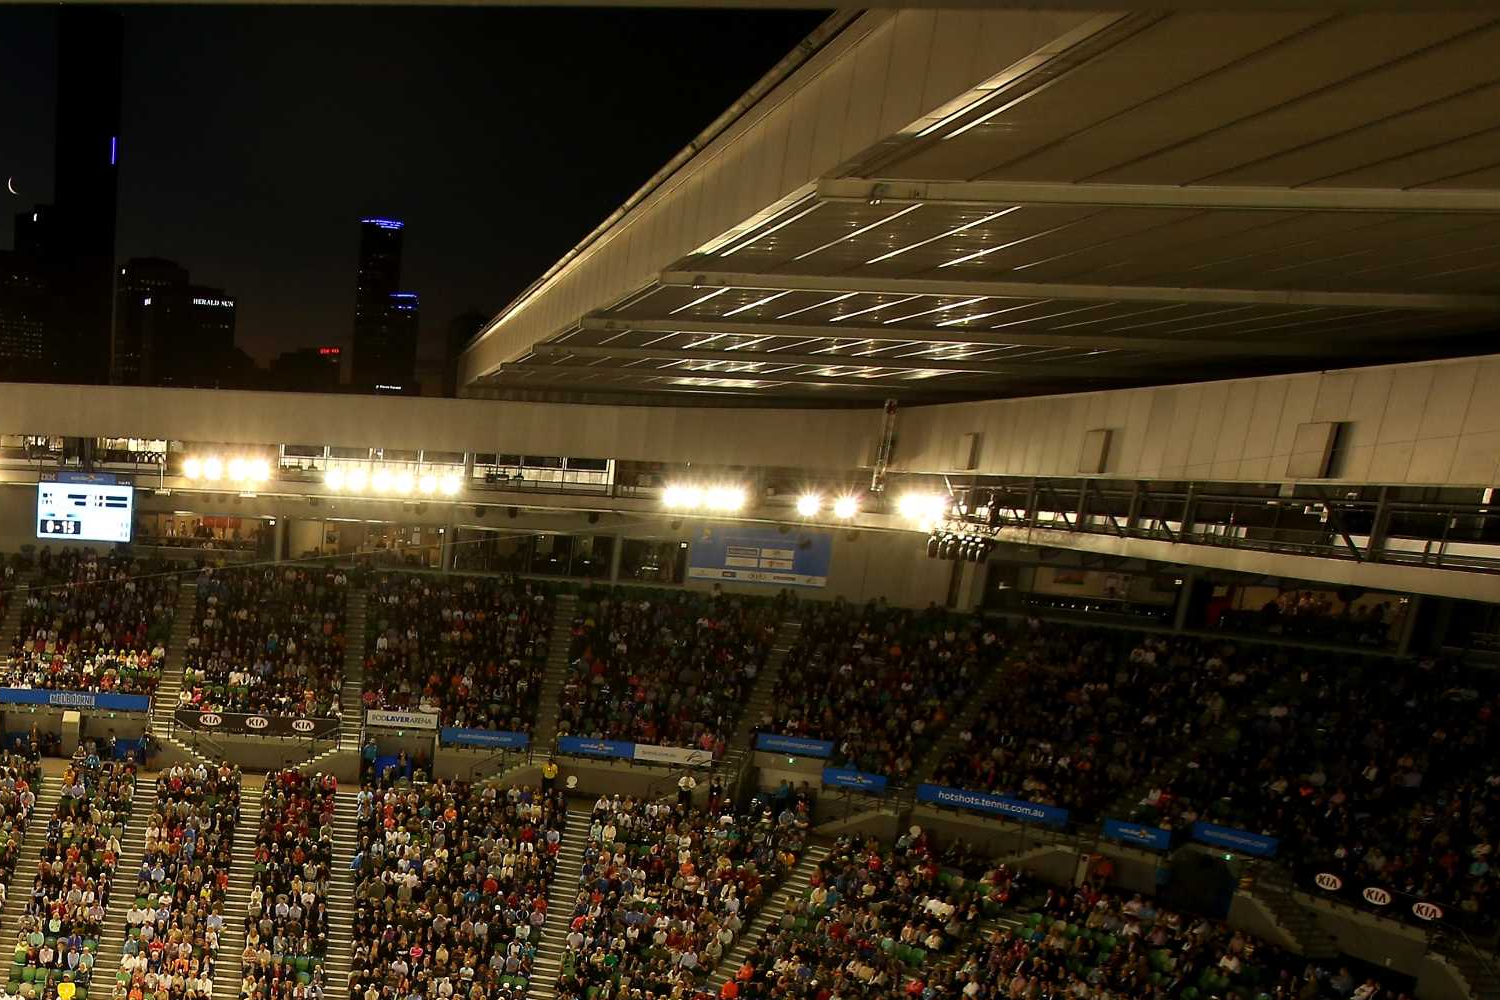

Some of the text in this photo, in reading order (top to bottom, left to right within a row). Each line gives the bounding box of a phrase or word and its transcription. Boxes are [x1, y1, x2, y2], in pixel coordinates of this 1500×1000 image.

[938, 790, 1045, 818] hotshots.tennis.com.au
[1318, 875, 1338, 888] KIA
[1366, 889, 1387, 903] KIA
[1415, 904, 1438, 918] KIA
